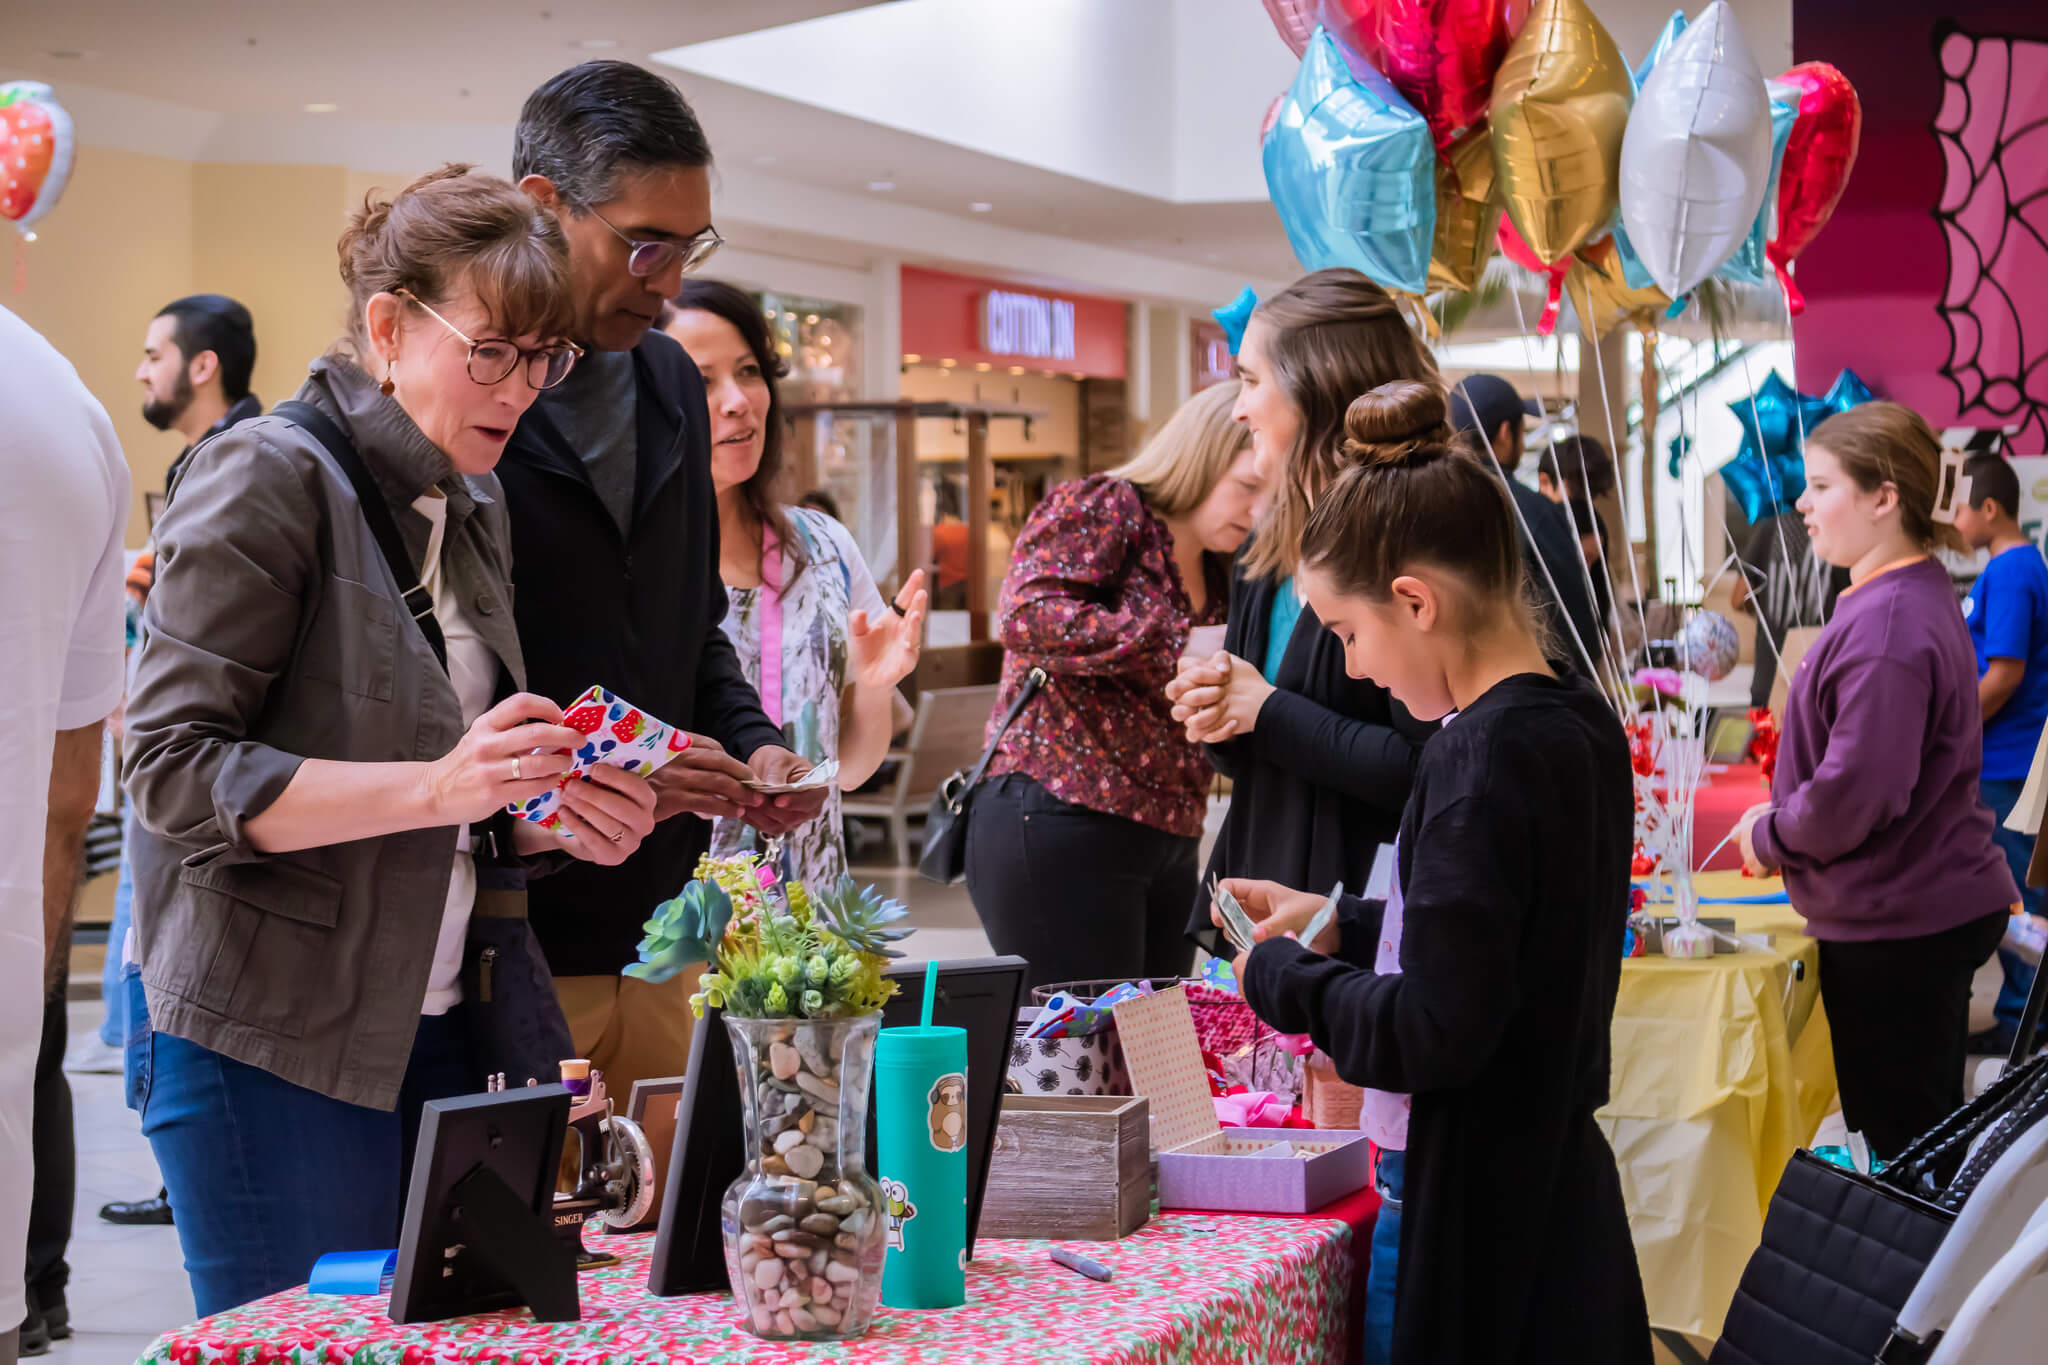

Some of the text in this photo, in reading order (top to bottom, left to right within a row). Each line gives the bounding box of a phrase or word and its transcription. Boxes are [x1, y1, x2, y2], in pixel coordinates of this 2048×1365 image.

[988, 290, 1075, 361] COTTON ON
[554, 1212, 584, 1227] SINGER
